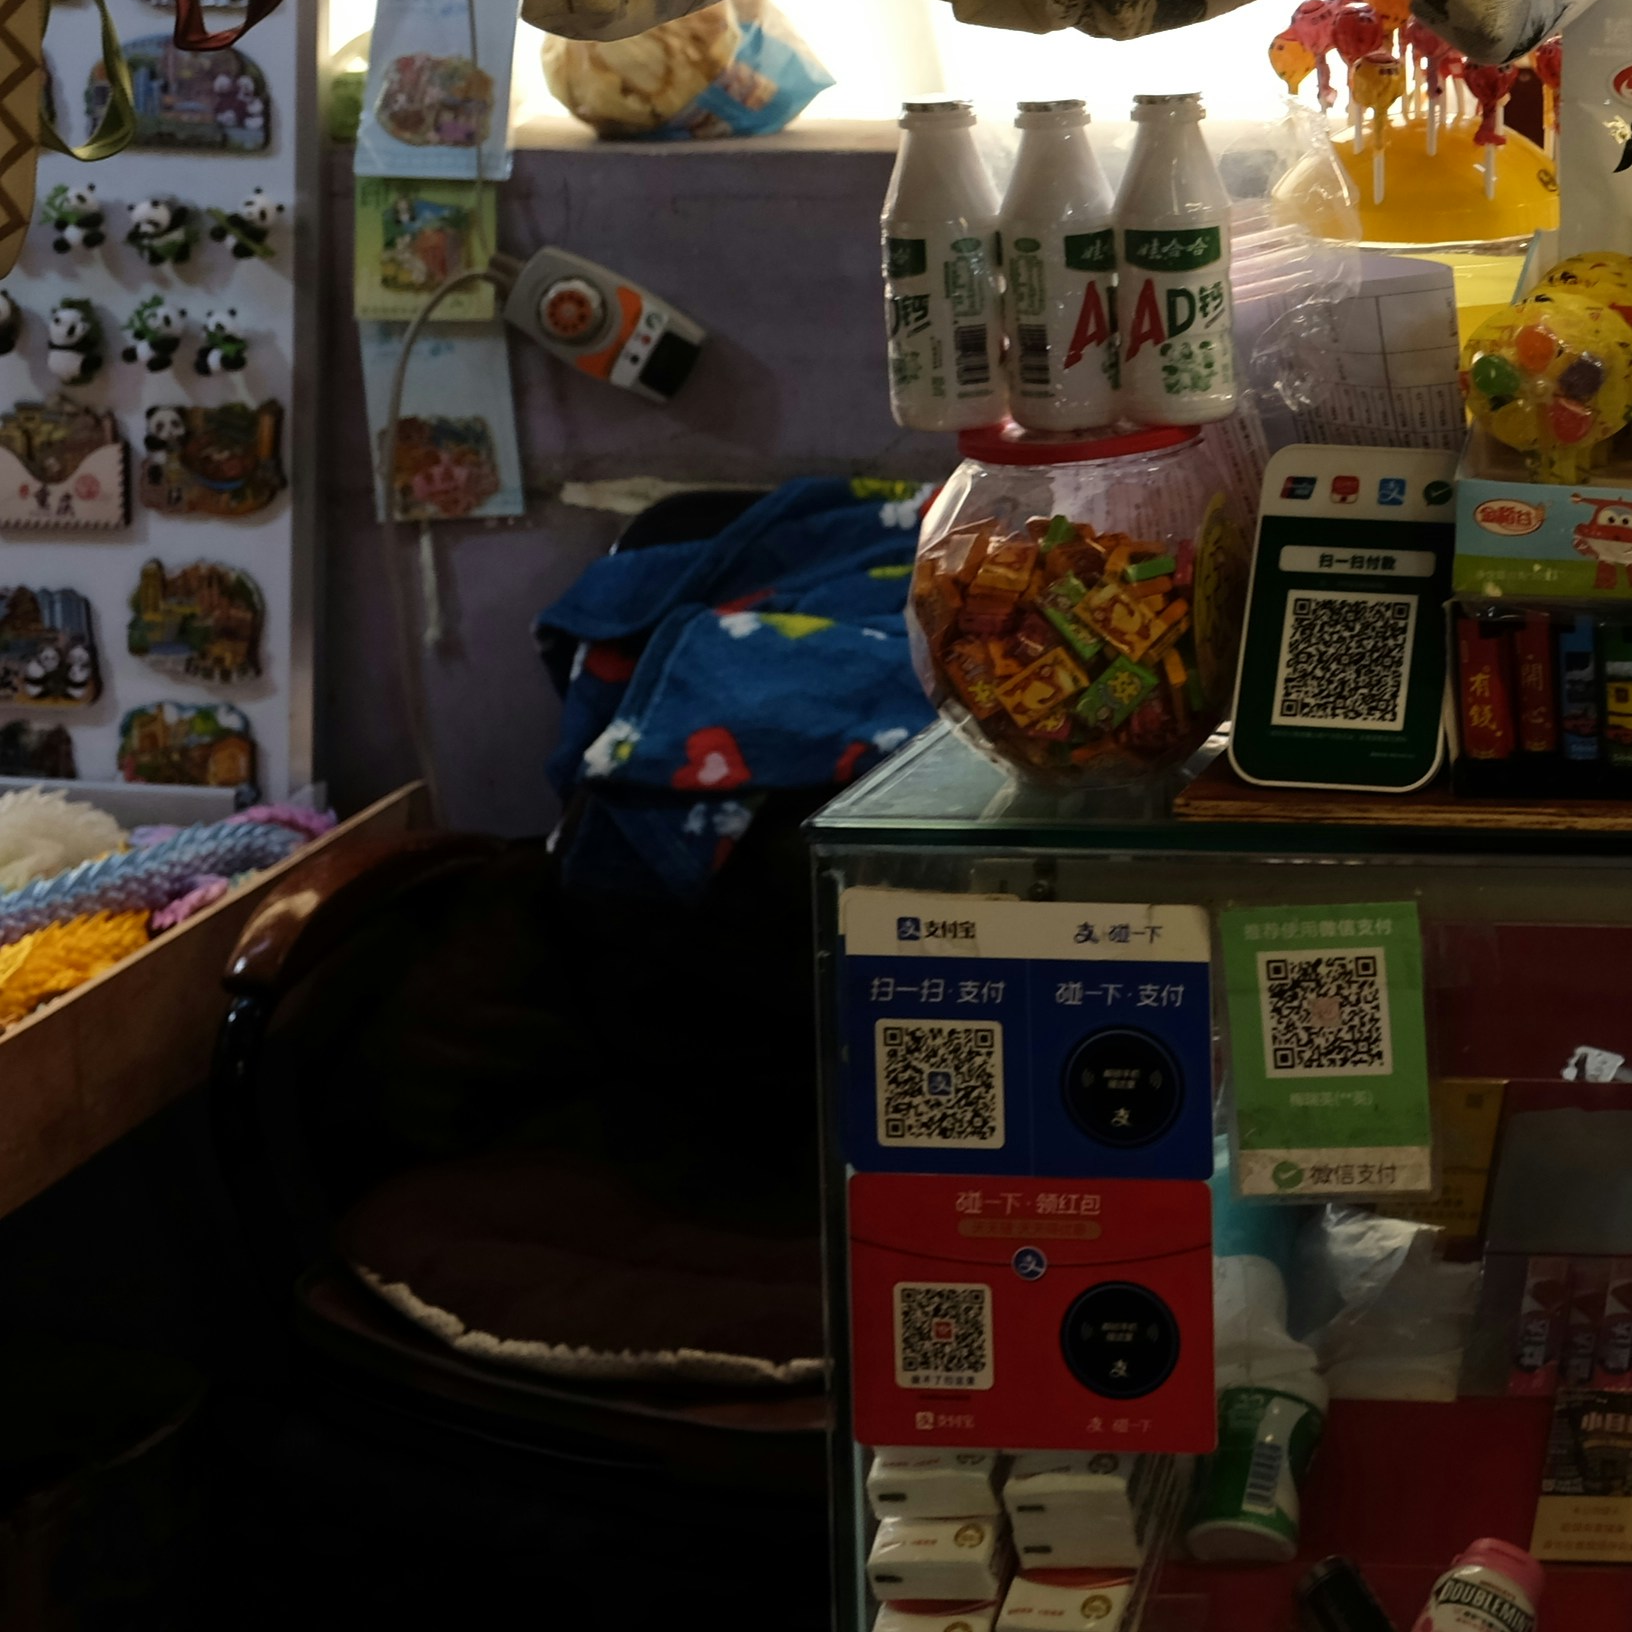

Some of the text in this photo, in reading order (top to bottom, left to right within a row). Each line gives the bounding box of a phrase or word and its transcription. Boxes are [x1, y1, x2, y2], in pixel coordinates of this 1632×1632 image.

[1318, 552, 1397, 571] 扫一扫付款
[923, 919, 1163, 945] 支付宝 碰一下
[869, 976, 1186, 1009] 扫一扫·支付 碰一下·支付
[1309, 1161, 1397, 1186] 微信支付
